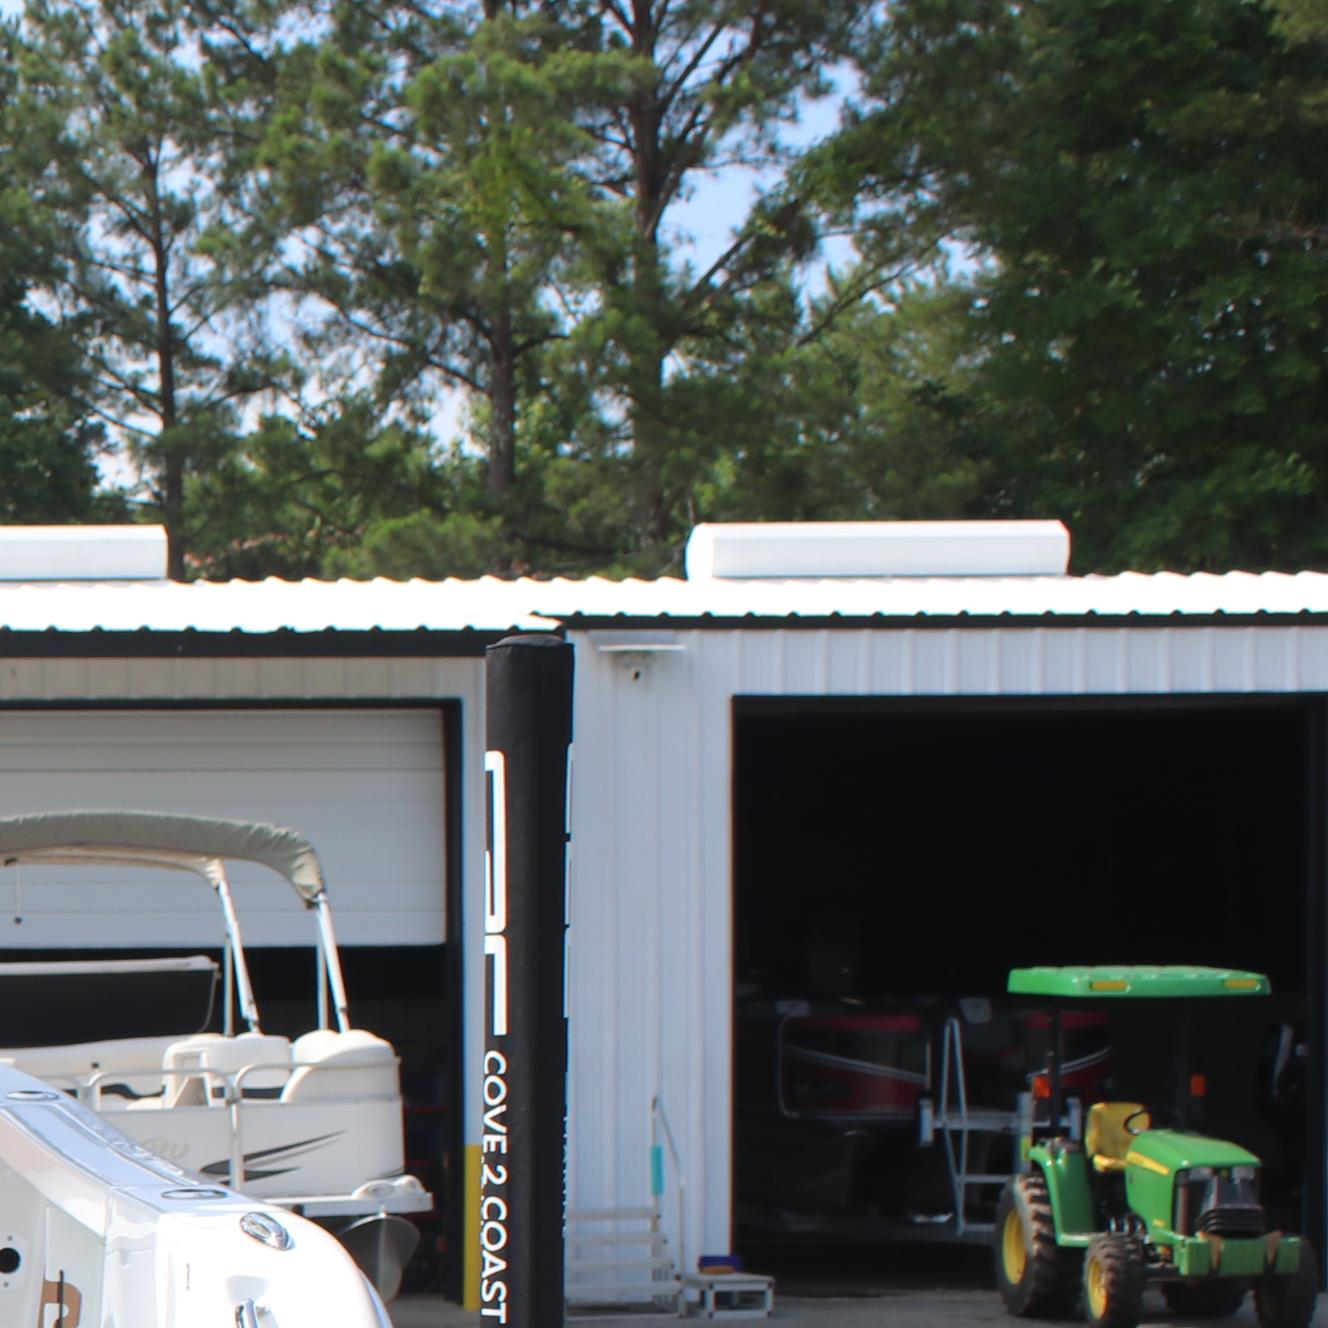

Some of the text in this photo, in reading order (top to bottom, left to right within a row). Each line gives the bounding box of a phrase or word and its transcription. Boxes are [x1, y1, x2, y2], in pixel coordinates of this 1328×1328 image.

[482, 1050, 507, 1154] COVE
[482, 1165, 507, 1186] 2
[480, 1196, 507, 1325] COAST
